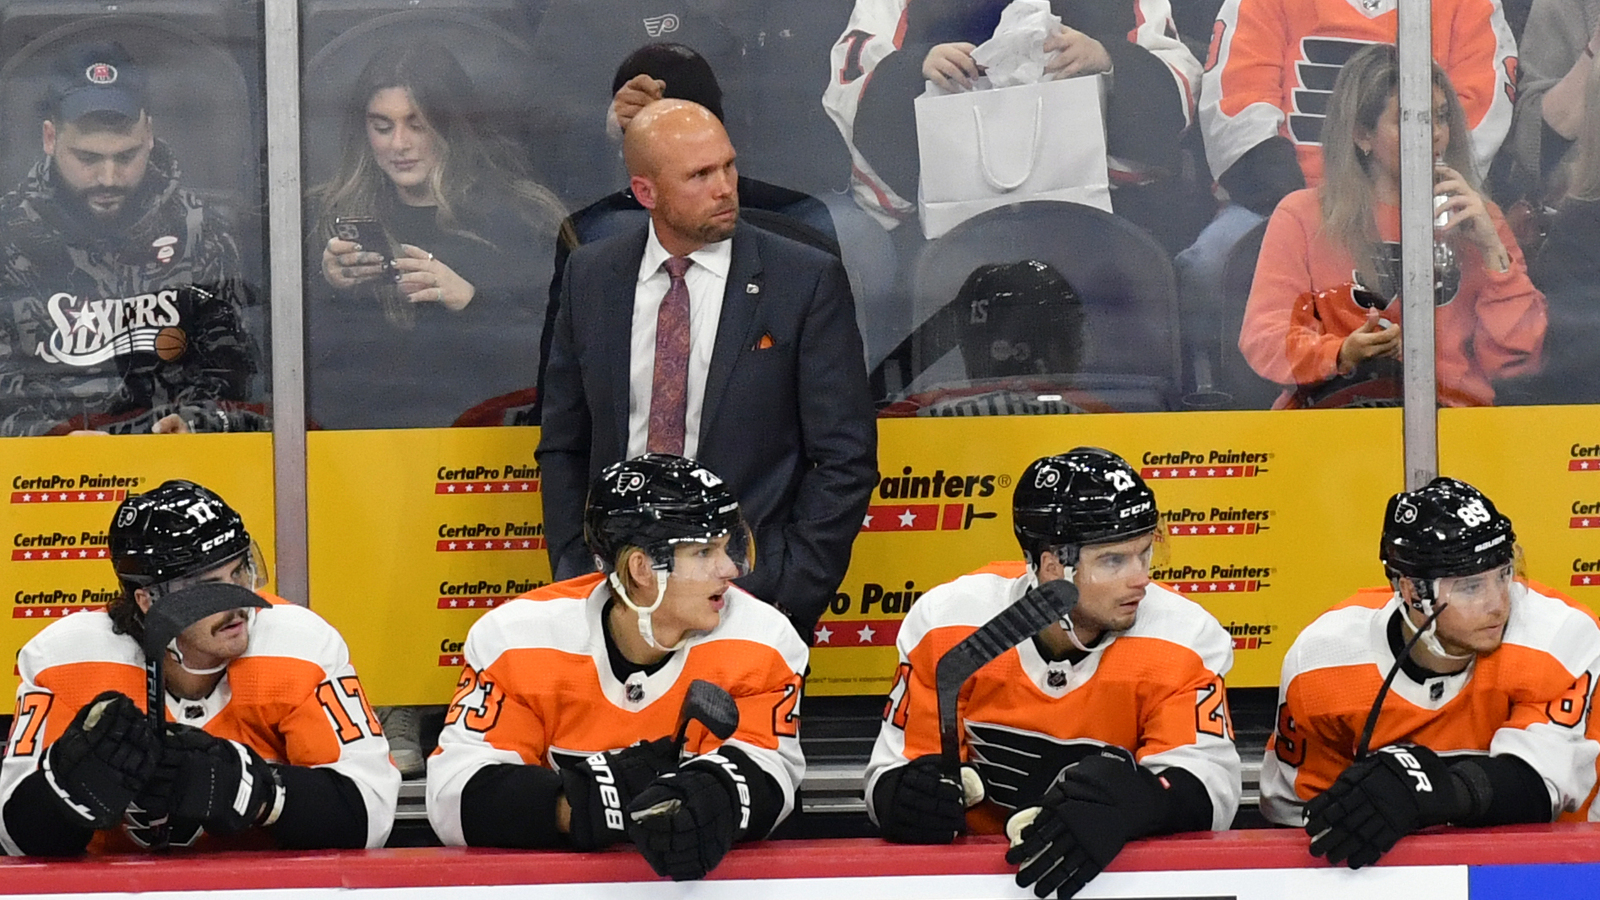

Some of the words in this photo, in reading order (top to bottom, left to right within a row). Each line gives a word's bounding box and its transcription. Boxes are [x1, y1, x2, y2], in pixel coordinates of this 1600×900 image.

[36, 290, 180, 362] SIXERS
[1142, 451, 1205, 465] CertaPro
[1208, 449, 1268, 464] Painters
[437, 466, 500, 480] CertaPro
[13, 475, 76, 489] CertaPro
[79, 474, 139, 488] Painters
[1119, 501, 1151, 518] CCM
[1210, 506, 1269, 521] Painters
[1457, 499, 1491, 527] 89
[438, 523, 501, 538] CertaPro
[13, 532, 77, 547] CertaPro
[201, 529, 235, 552] CCM
[1211, 564, 1270, 578] Painters
[439, 581, 502, 595] CertaPro
[14, 590, 77, 604] CertaPro
[444, 663, 506, 733] 23
[315, 675, 383, 745] 17
